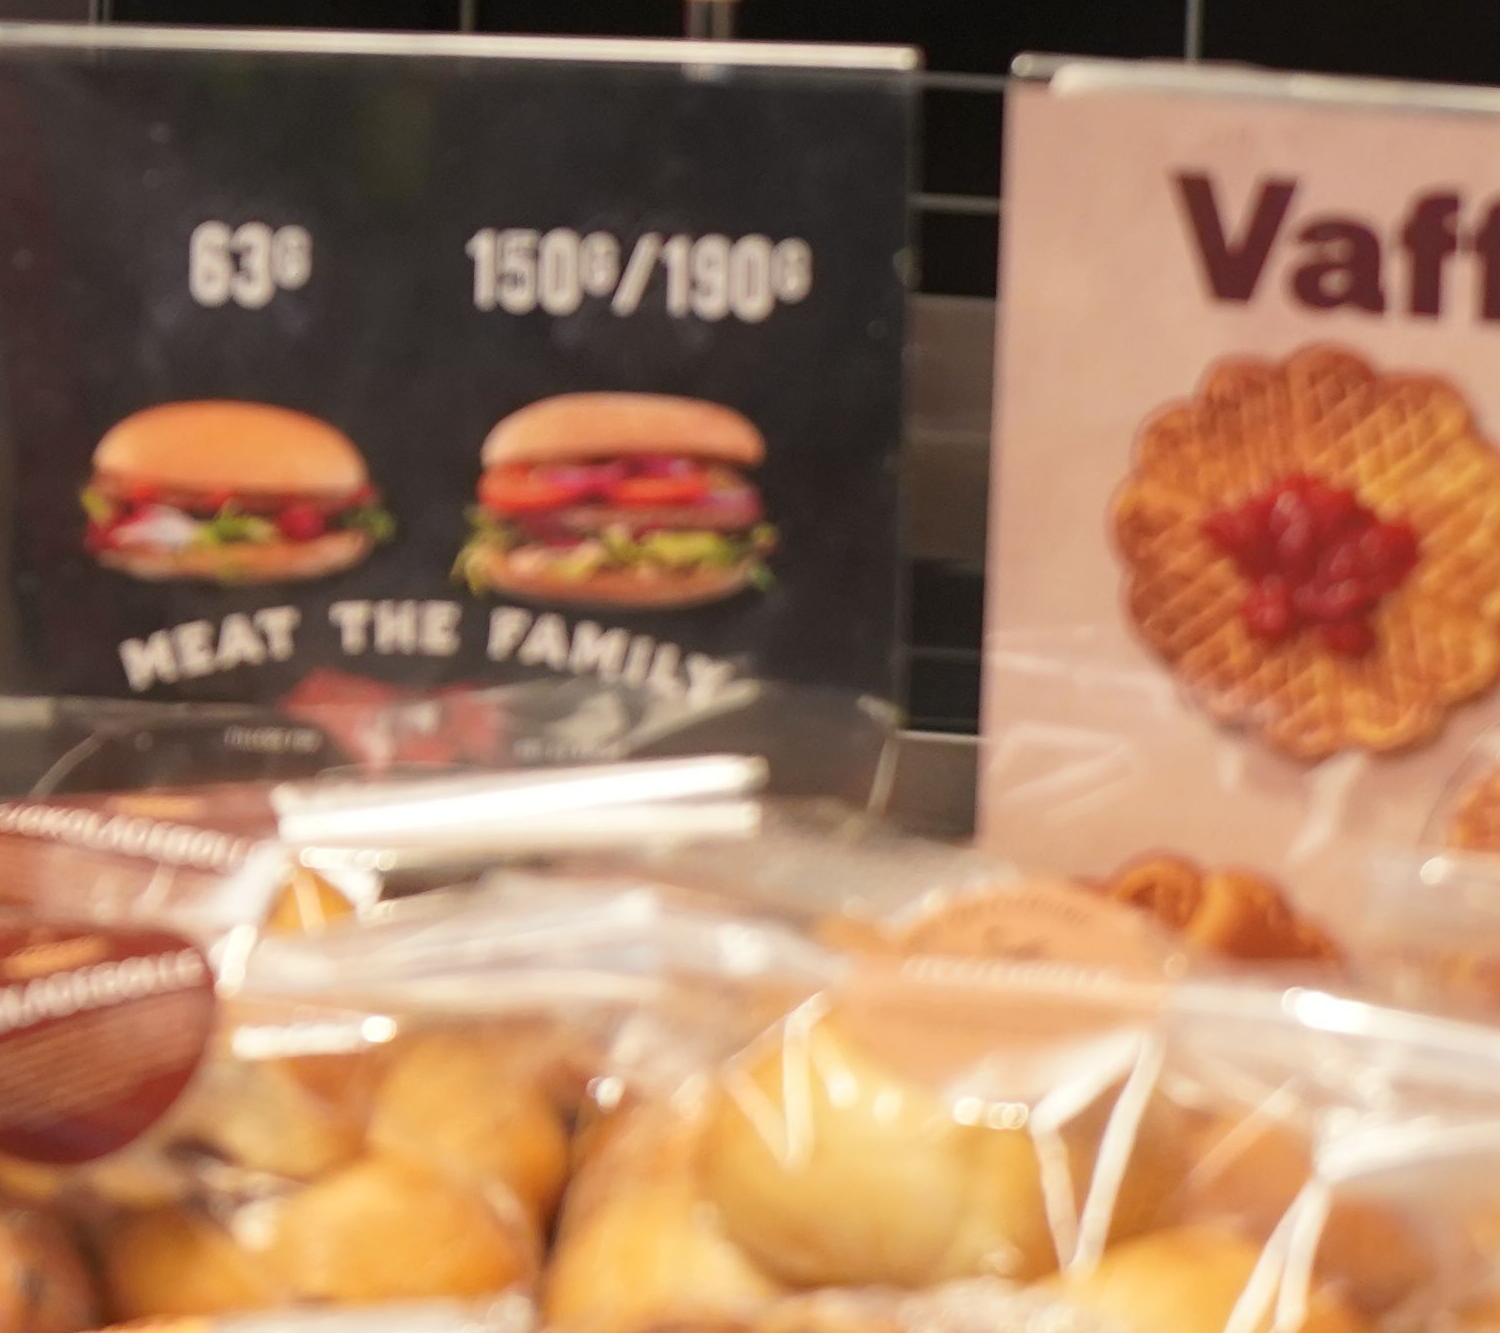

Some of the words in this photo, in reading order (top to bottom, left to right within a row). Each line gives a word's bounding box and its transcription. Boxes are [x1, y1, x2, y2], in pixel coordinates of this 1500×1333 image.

[118, 605, 300, 692] MEAT
[328, 599, 463, 658] THE
[487, 605, 736, 711] FAMILY
